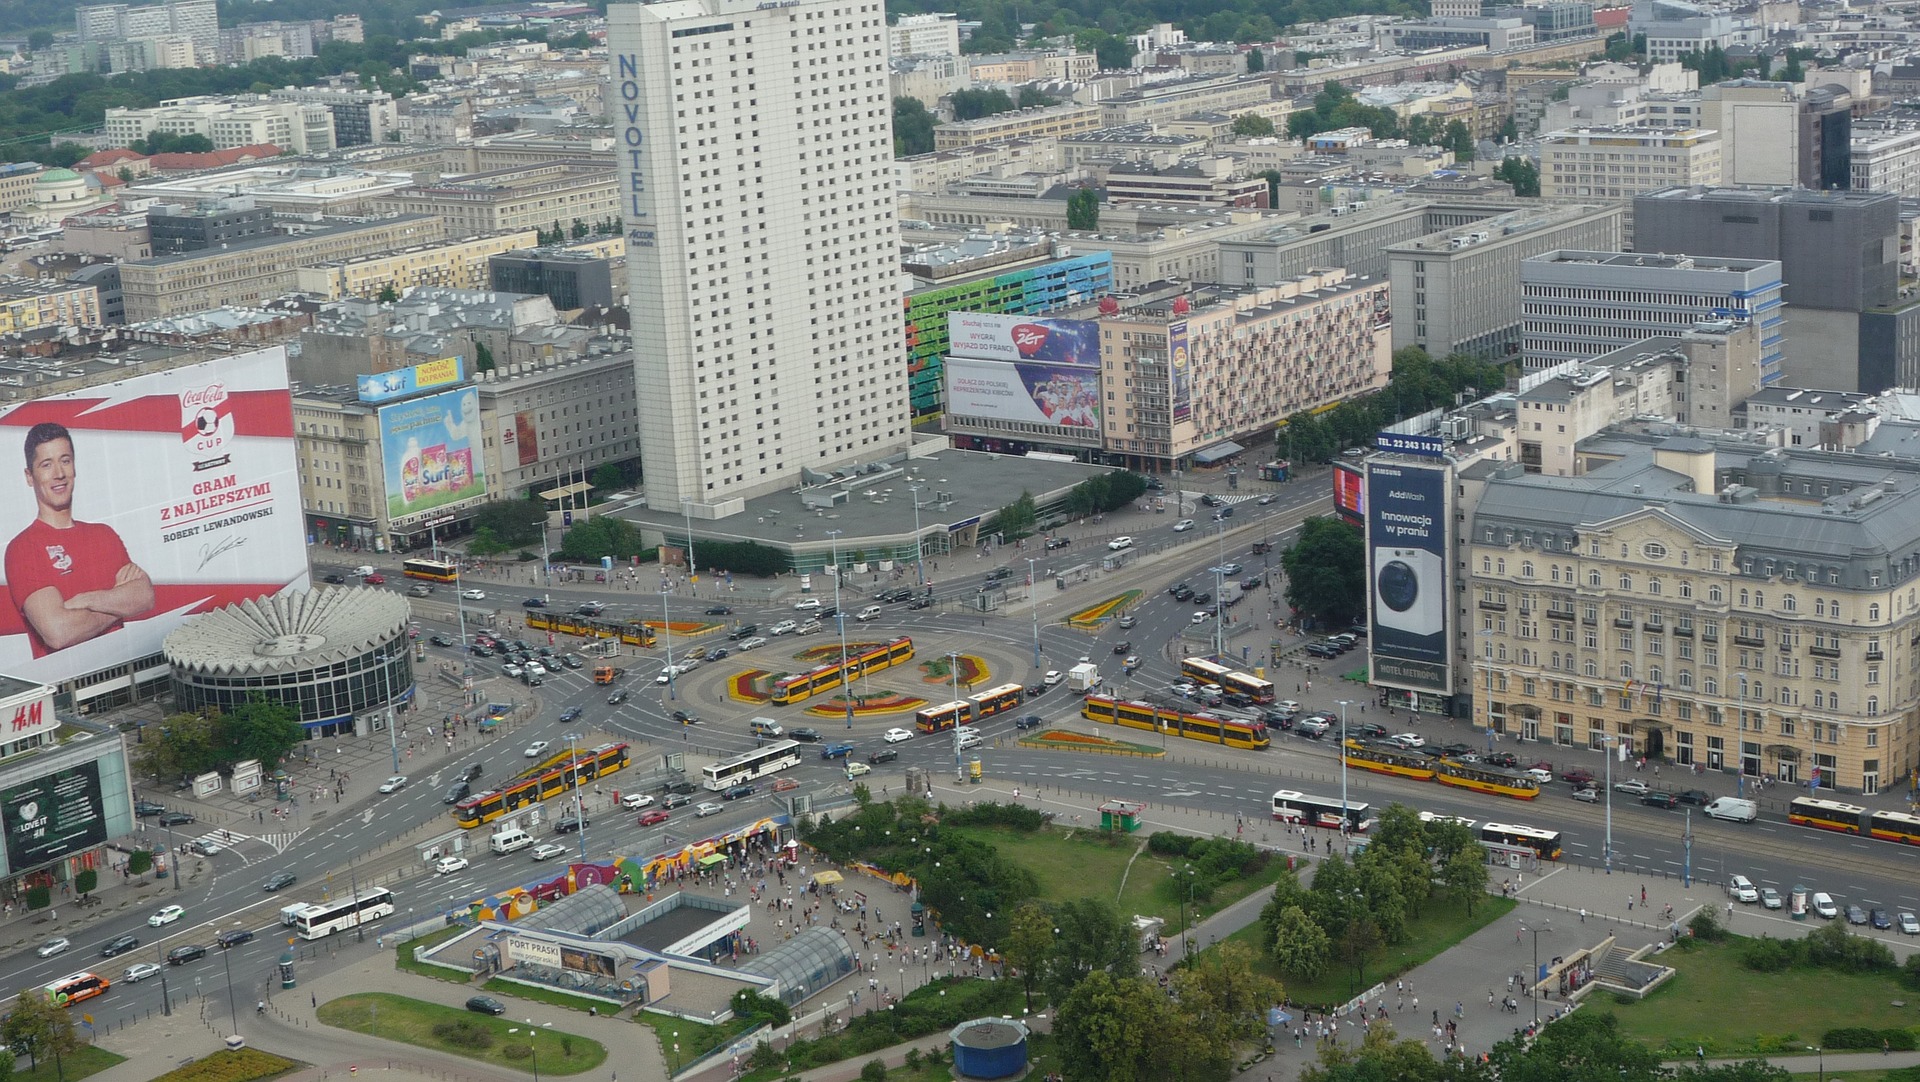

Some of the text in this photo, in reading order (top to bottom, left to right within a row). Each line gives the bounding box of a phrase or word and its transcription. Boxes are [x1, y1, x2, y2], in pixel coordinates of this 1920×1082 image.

[619, 54, 647, 217] NOVOTEL
[1122, 306, 1165, 317] HUAWEI
[970, 333, 995, 341] WYGRAJ
[1016, 333, 1045, 345] ZET
[953, 342, 978, 350] WYJAZD
[989, 344, 1014, 352] FRANCJI
[383, 376, 406, 392] Surf
[419, 375, 428, 384] DO
[183, 384, 224, 408] Coca-Cola
[197, 438, 222, 450] CUP
[1378, 438, 1442, 452] TEL. 22 243 14 78
[423, 464, 450, 485] Surf
[451, 467, 465, 478] Surf
[1372, 467, 1402, 476] SAMSUNG
[193, 474, 237, 495] GRAM
[160, 482, 271, 521] Z NAJLEPSZYMI
[1389, 490, 1425, 501] AddWash
[163, 507, 273, 543] ROBERT LEWANDOWSKI
[1381, 511, 1432, 526] Innowacja
[1386, 525, 1429, 537] w praniu
[1380, 665, 1440, 681] HOTEL METROPOL
[11, 700, 42, 732] H&M
[509, 939, 559, 956] PORT PRASKI
